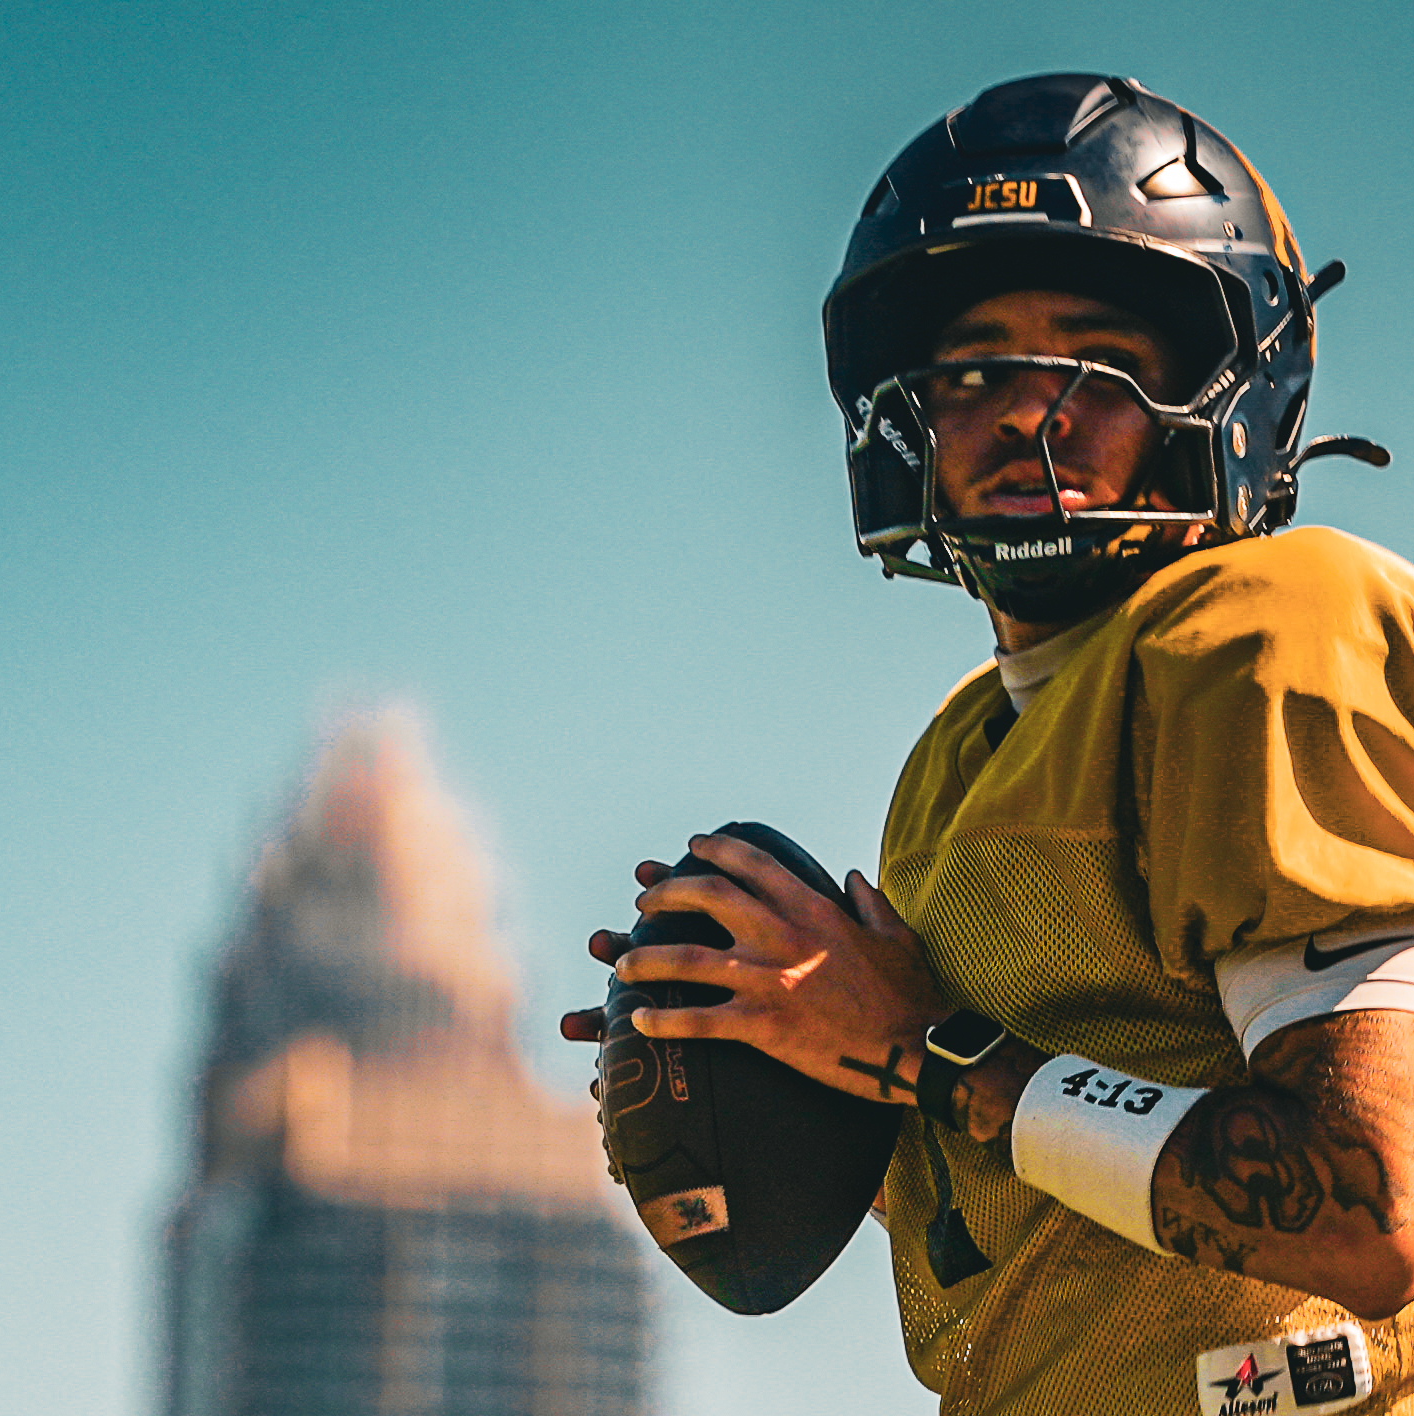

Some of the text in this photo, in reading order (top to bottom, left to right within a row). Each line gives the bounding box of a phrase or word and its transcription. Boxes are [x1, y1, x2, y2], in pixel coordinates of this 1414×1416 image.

[967, 181, 1037, 211] JCSU
[994, 536, 1073, 561] Riddell
[1061, 1068, 1164, 1115] 4:13
